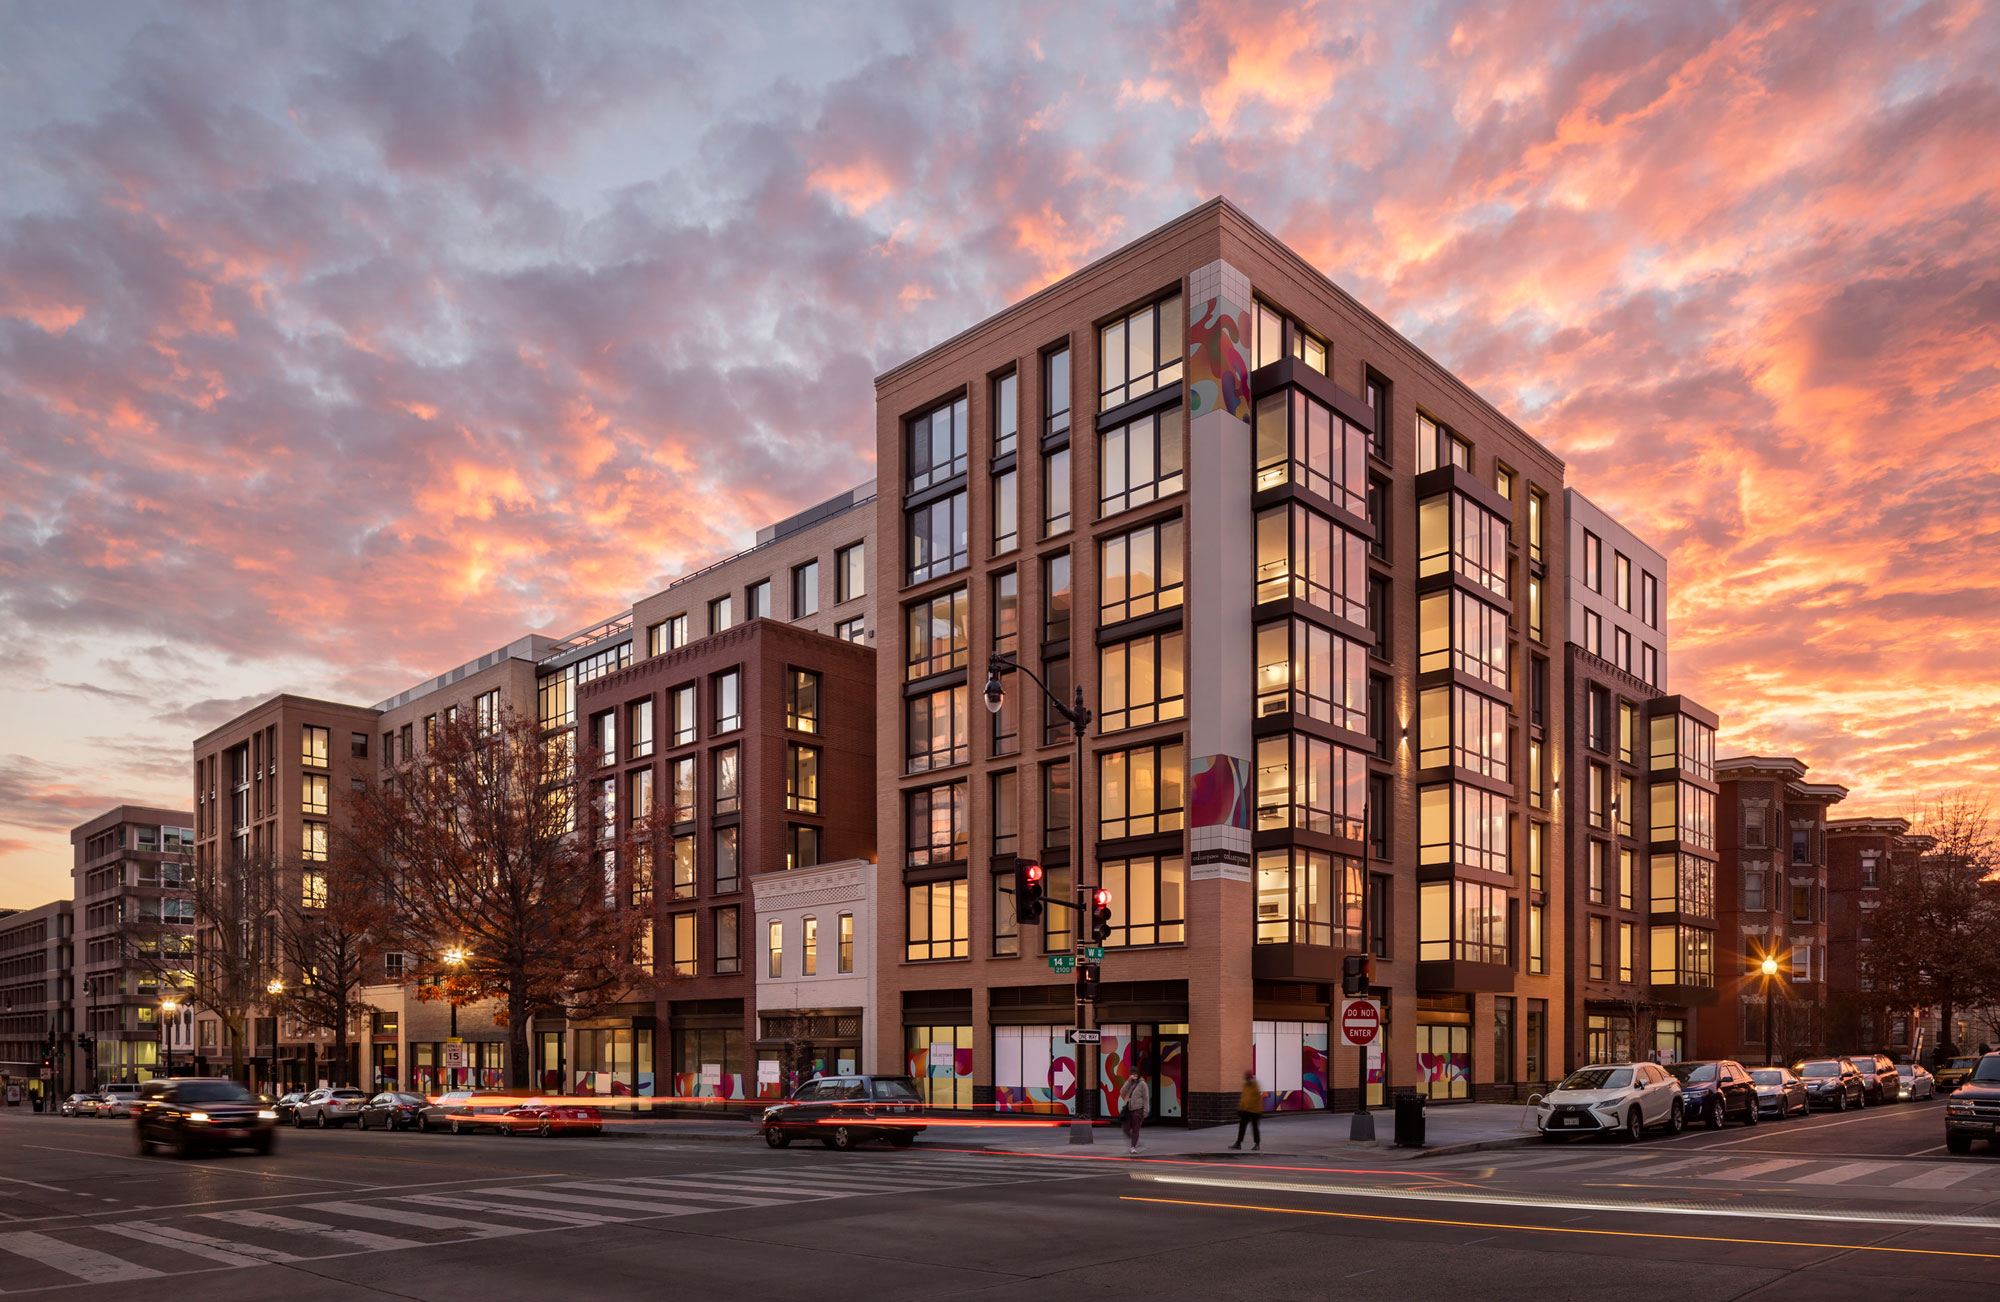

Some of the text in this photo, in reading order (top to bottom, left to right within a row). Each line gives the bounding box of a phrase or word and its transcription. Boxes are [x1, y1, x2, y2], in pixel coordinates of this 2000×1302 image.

[1087, 948, 1095, 956] W
[1053, 957, 1063, 966] 14
[1347, 1009, 1375, 1017] DO NOT
[1349, 1029, 1372, 1037] ENTER
[449, 1052, 460, 1060] 15
